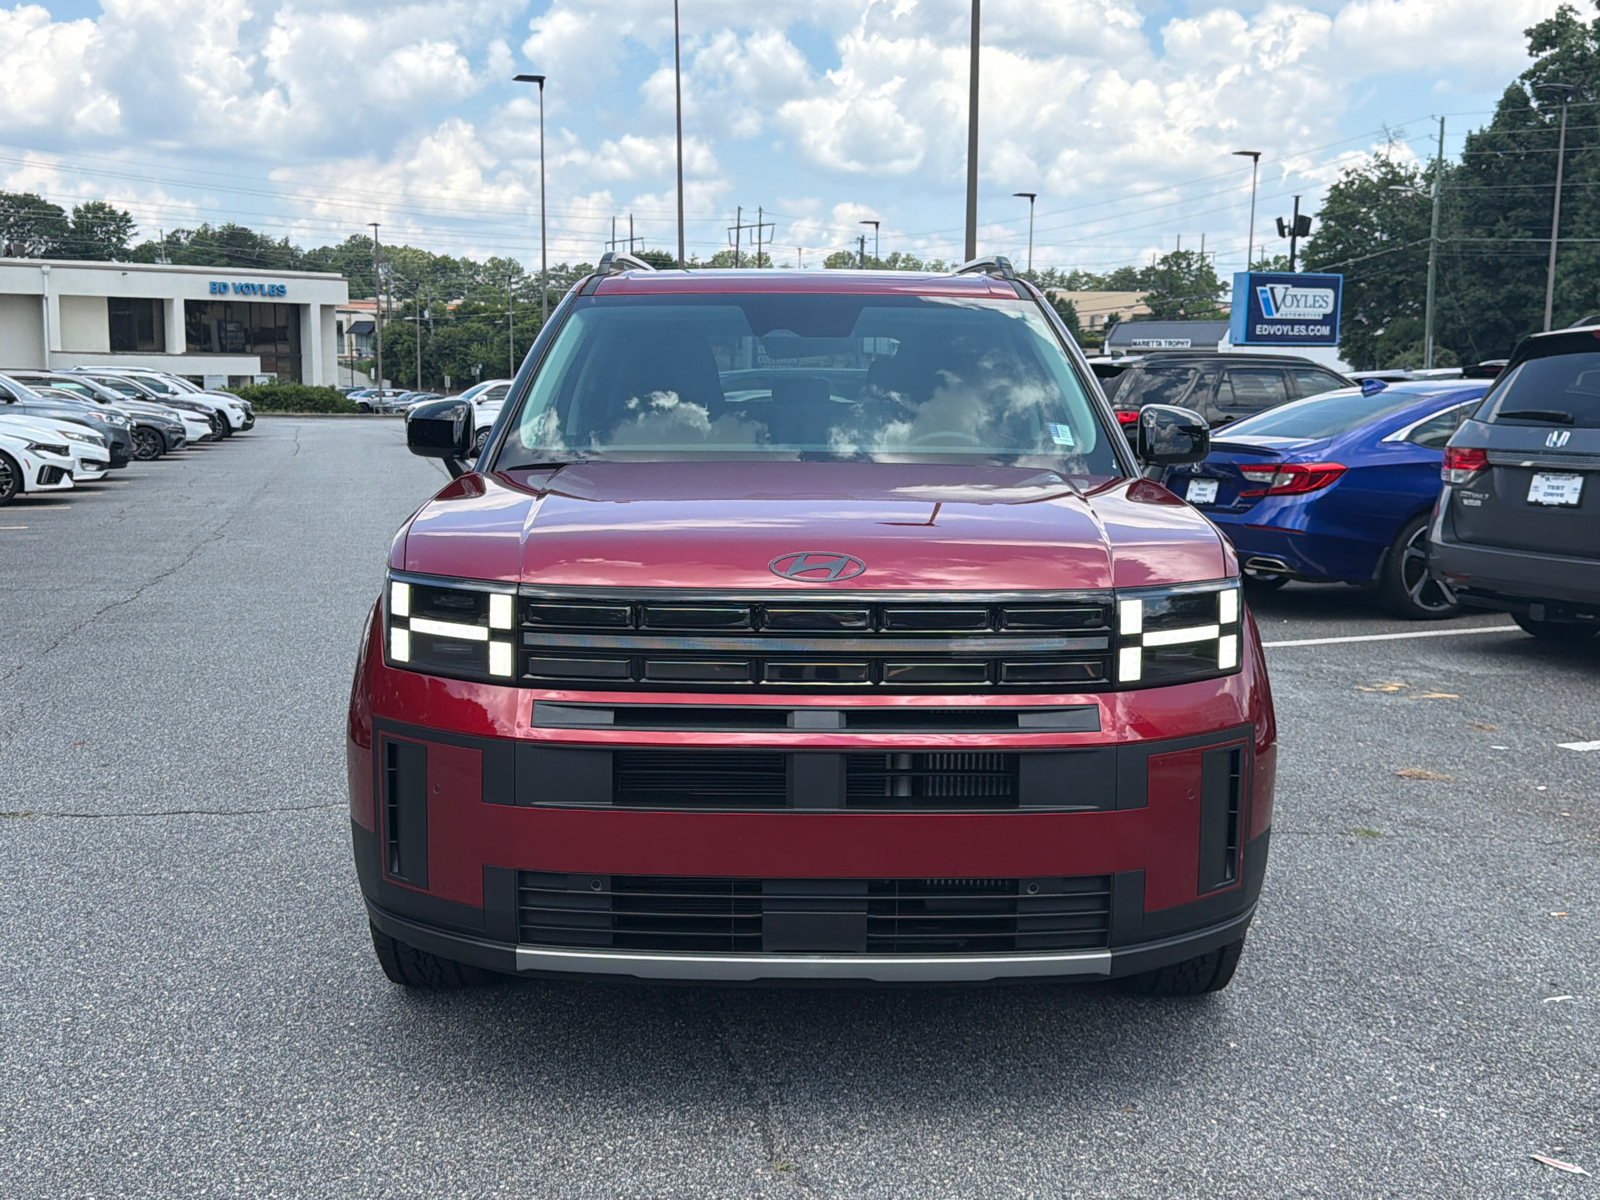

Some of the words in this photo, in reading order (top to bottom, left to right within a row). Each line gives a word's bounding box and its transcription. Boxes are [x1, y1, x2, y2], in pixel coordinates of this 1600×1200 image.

[209, 281, 230, 294] ED
[231, 282, 287, 296] VOYLES
[1255, 324, 1331, 336] EDVOYLES.COM
[1164, 340, 1190, 348] TROPHY
